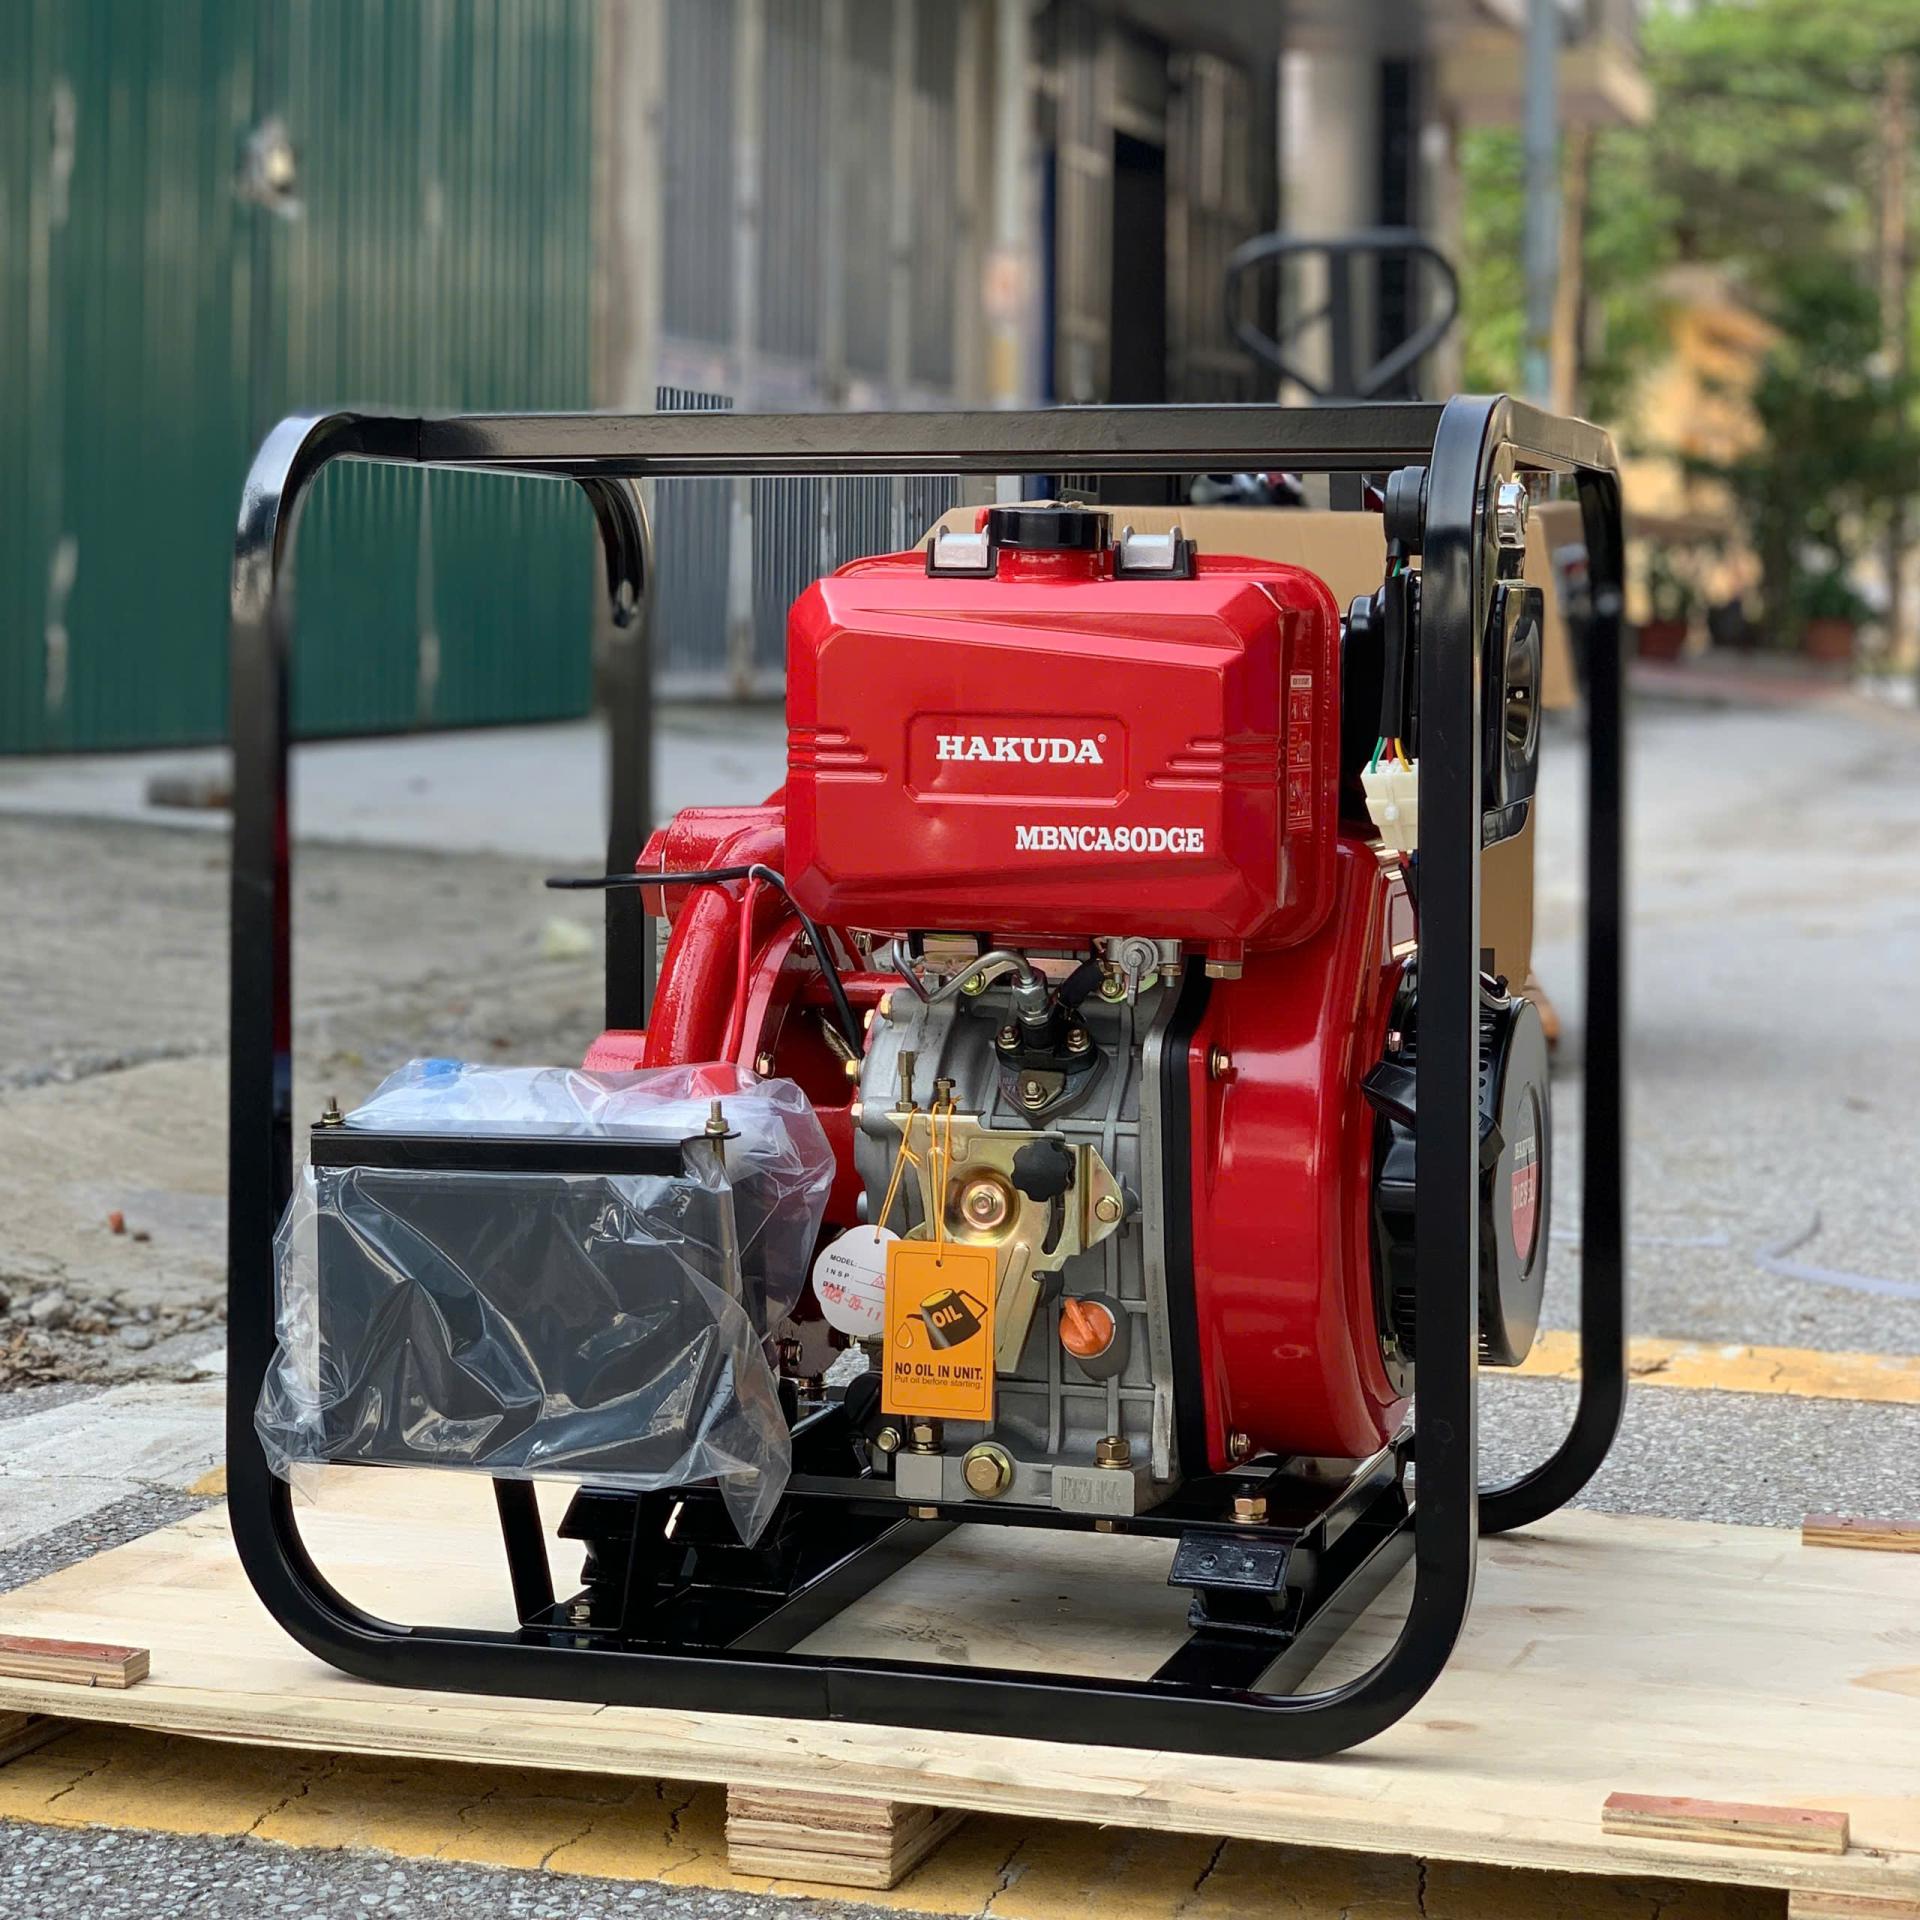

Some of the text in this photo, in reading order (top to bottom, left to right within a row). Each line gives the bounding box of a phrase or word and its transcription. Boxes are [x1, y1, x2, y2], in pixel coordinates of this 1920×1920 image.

[1015, 825, 1204, 853] MBNCA80DGE
[830, 1254, 858, 1268] MODEL:
[932, 1305, 963, 1328] OIL
[895, 1363, 983, 1380] NO OIL IN UNIT.
[894, 1375, 909, 1384] Put
[922, 1377, 948, 1386] before
